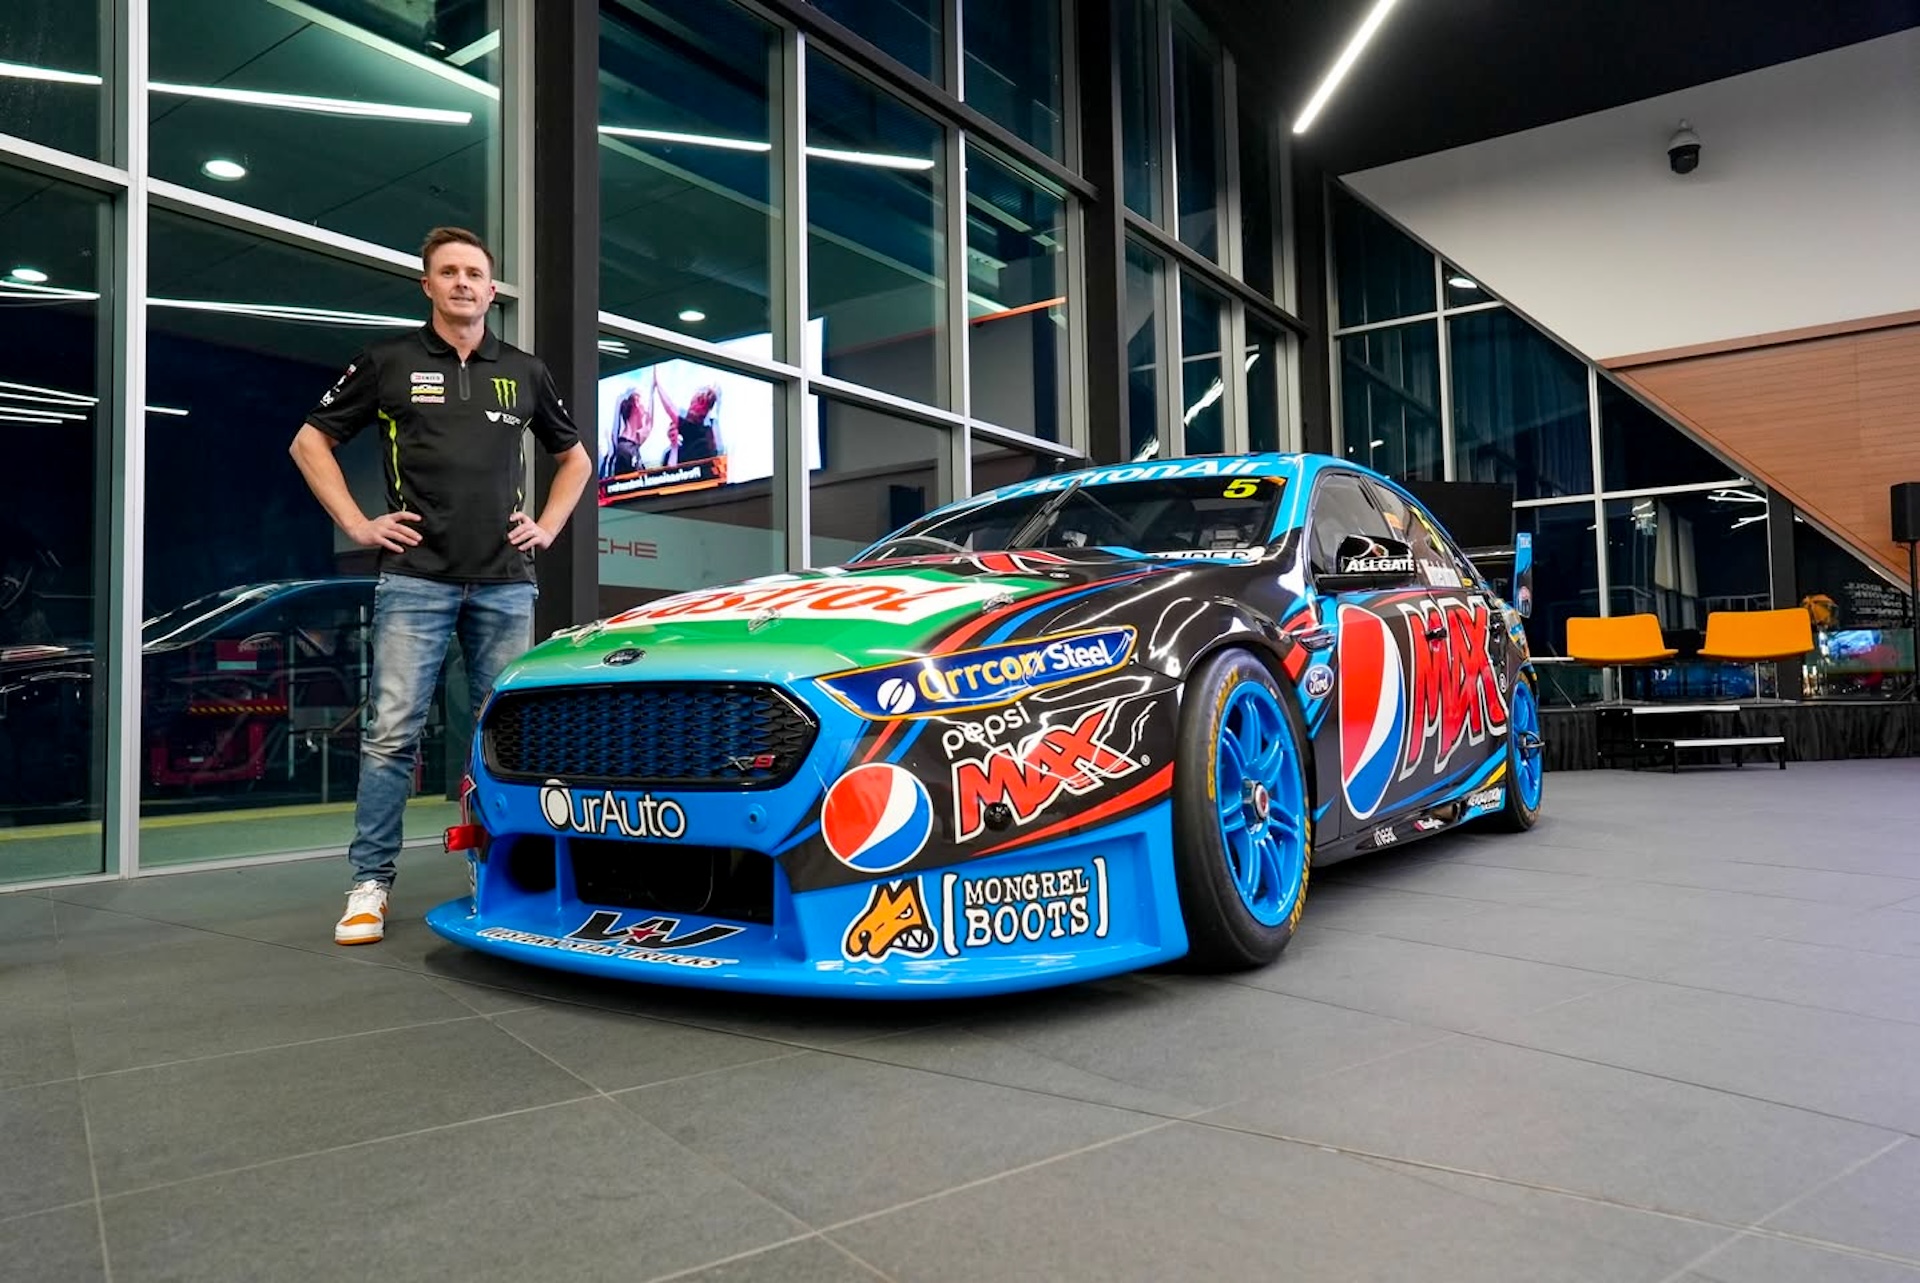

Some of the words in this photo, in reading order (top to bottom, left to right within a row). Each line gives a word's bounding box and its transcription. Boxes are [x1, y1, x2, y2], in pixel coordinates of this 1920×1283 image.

[1019, 459, 1273, 494] ActronAir
[1223, 478, 1261, 498] 5
[917, 651, 1045, 700] Orrcon
[1051, 640, 1113, 670] Steel
[1399, 597, 1508, 782] MAX
[942, 701, 1031, 759] pepsi
[951, 698, 1141, 843] MAX
[540, 779, 686, 838] OurAuto
[964, 868, 1089, 906] MONGREL
[965, 897, 1089, 946] BOOTS
